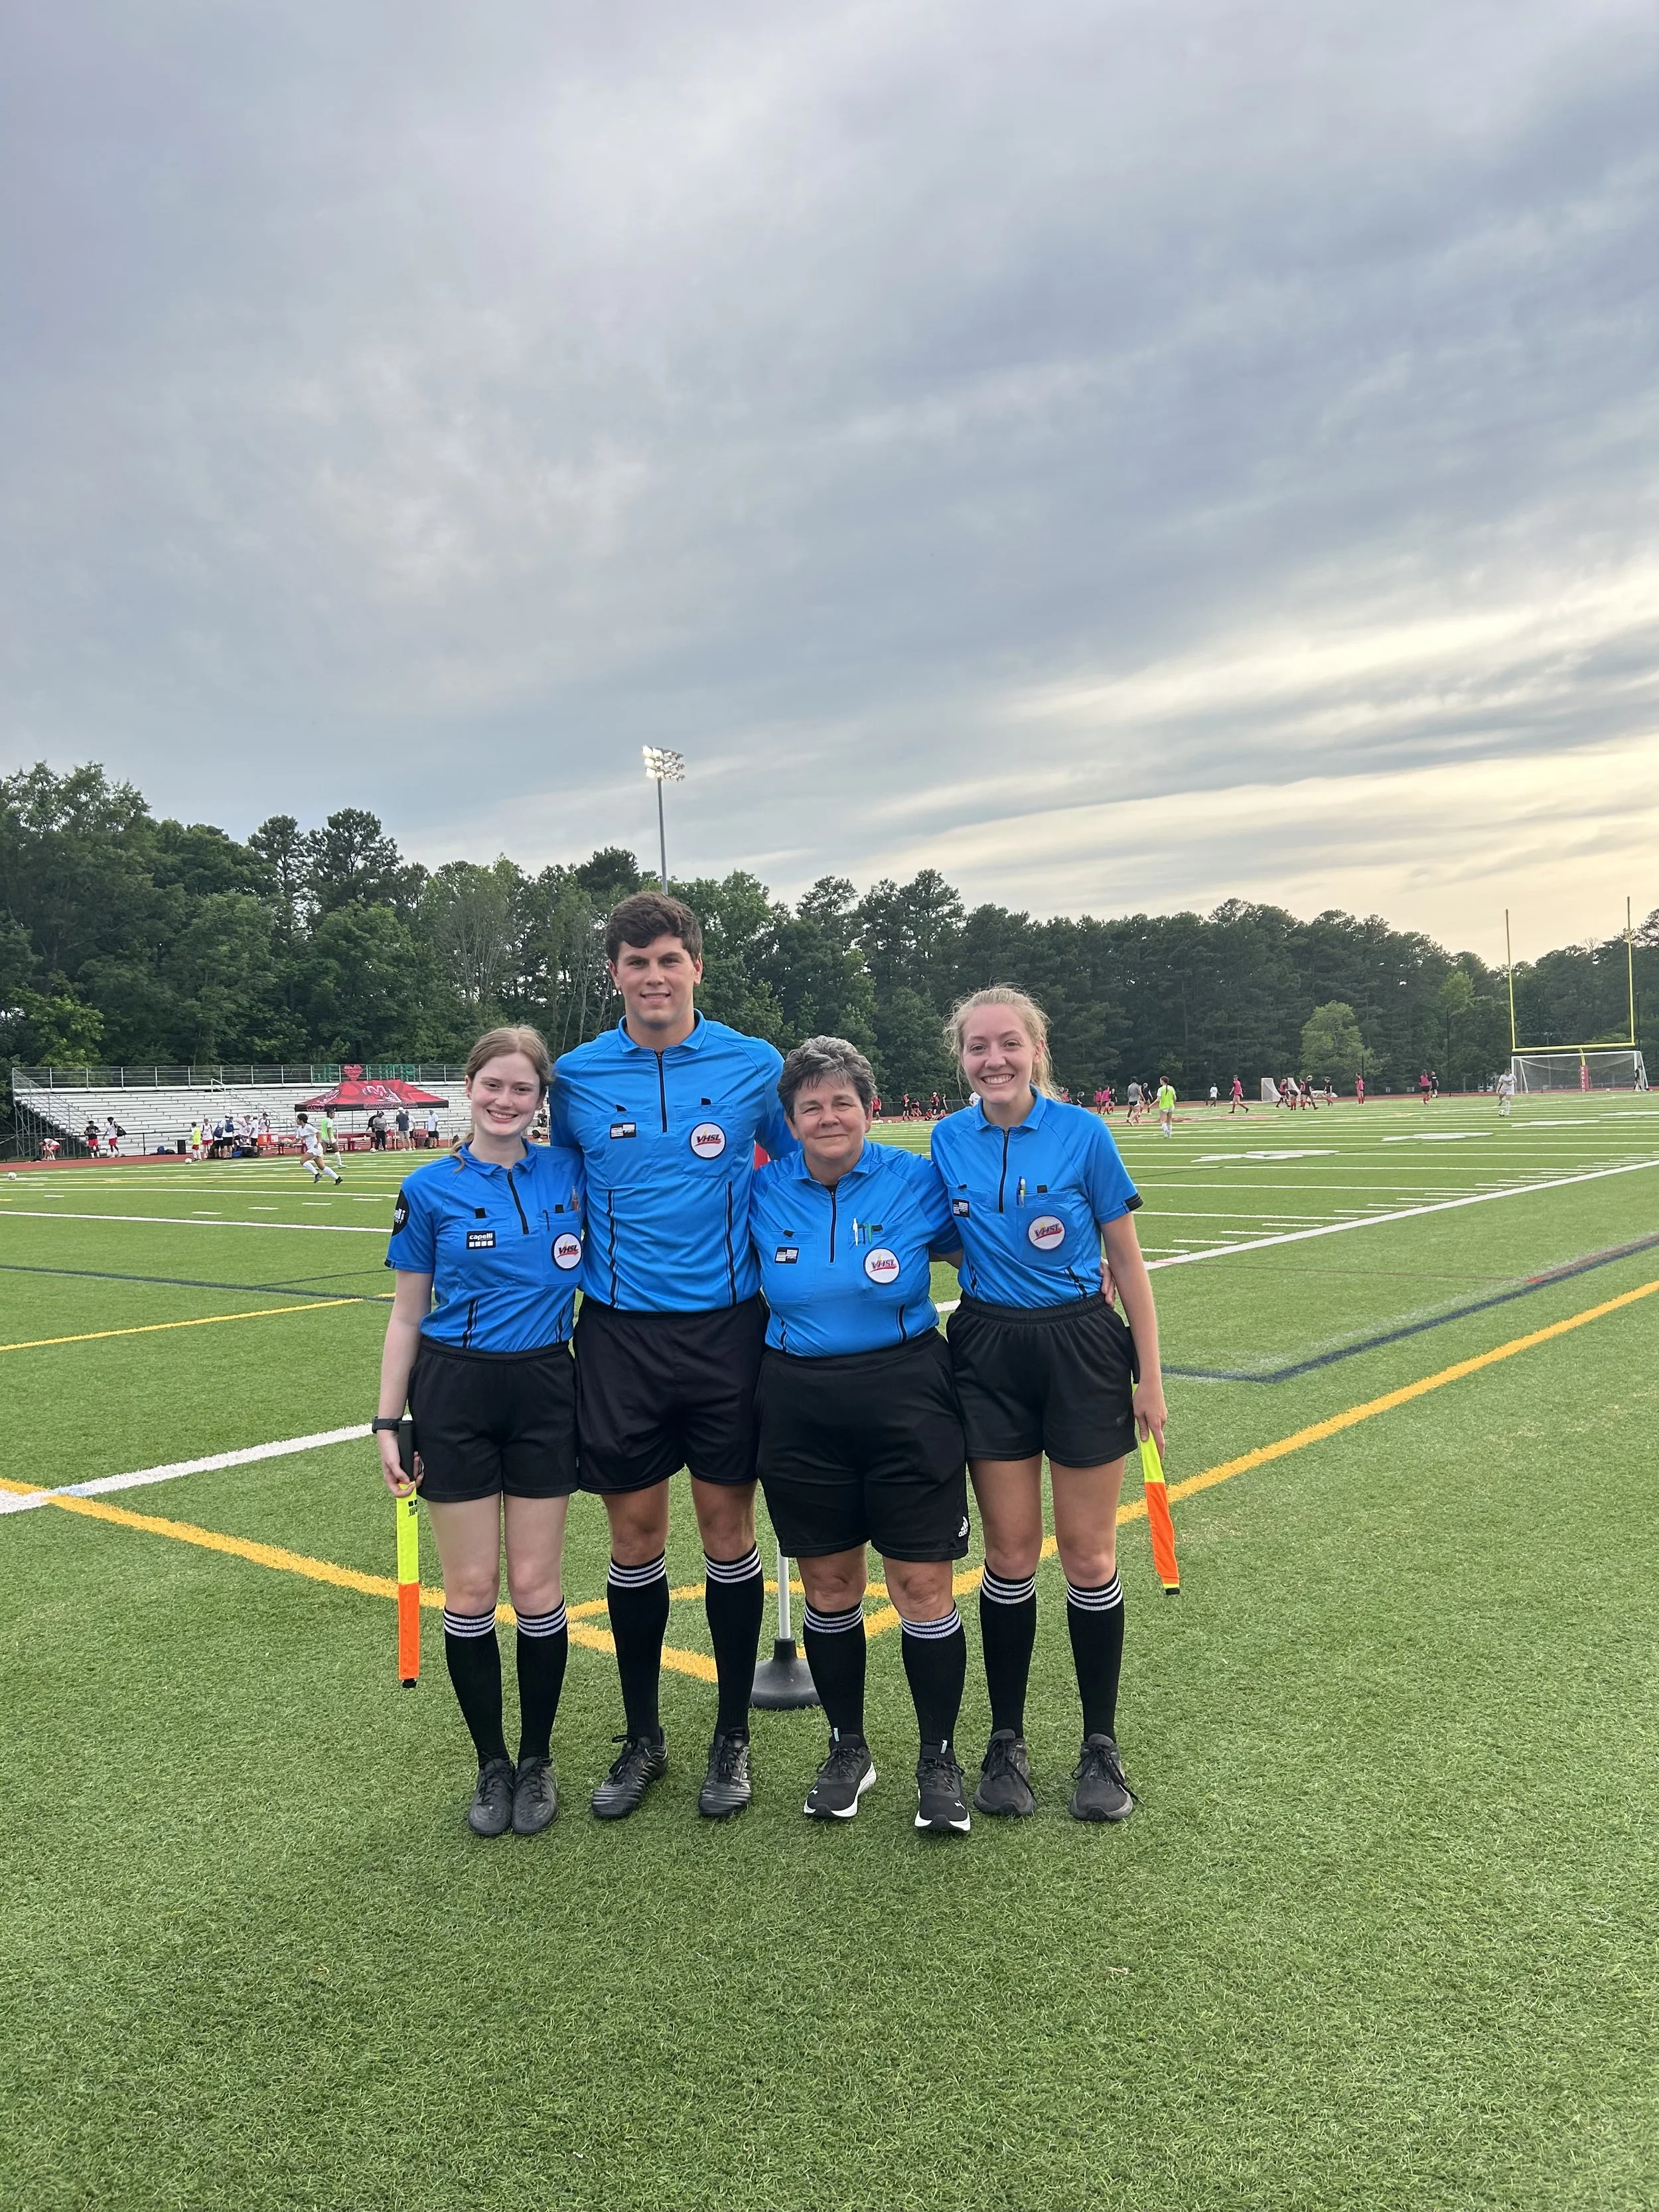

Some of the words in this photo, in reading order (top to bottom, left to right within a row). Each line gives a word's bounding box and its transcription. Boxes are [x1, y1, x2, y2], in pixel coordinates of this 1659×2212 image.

[696, 1134, 721, 1143] VHSL
[1034, 1222, 1062, 1237] VHSL
[469, 1232, 493, 1241] capelli
[558, 1244, 579, 1254] VHSL
[871, 1258, 897, 1269] VHSL
